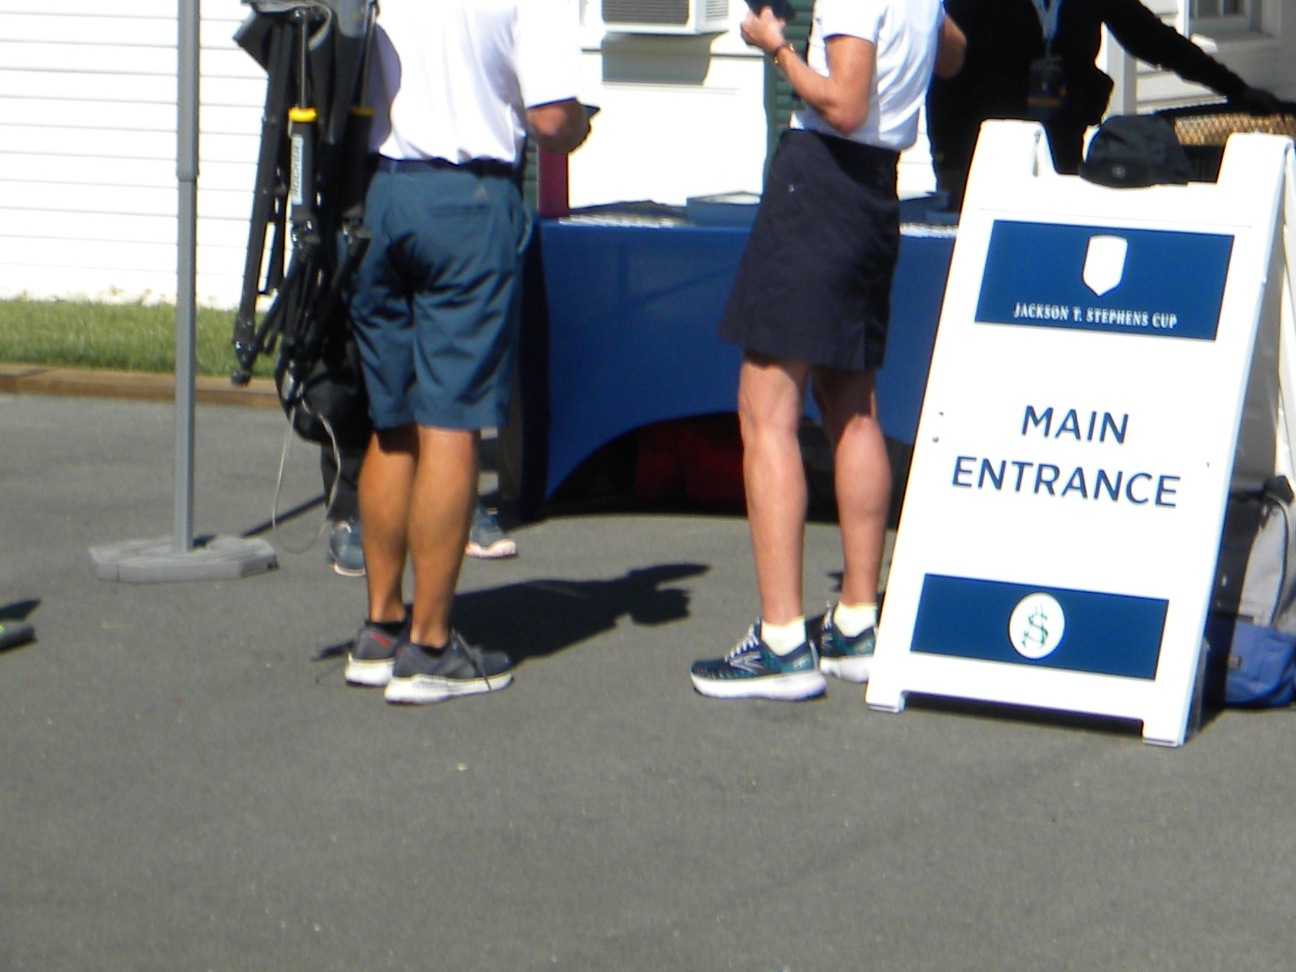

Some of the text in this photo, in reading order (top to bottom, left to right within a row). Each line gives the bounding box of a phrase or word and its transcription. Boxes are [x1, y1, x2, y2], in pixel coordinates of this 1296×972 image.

[1013, 301, 1177, 329] JACKSON T. STEPHENS CUP
[1021, 405, 1130, 445] MAIN
[952, 455, 1181, 508] ENTRANCE
